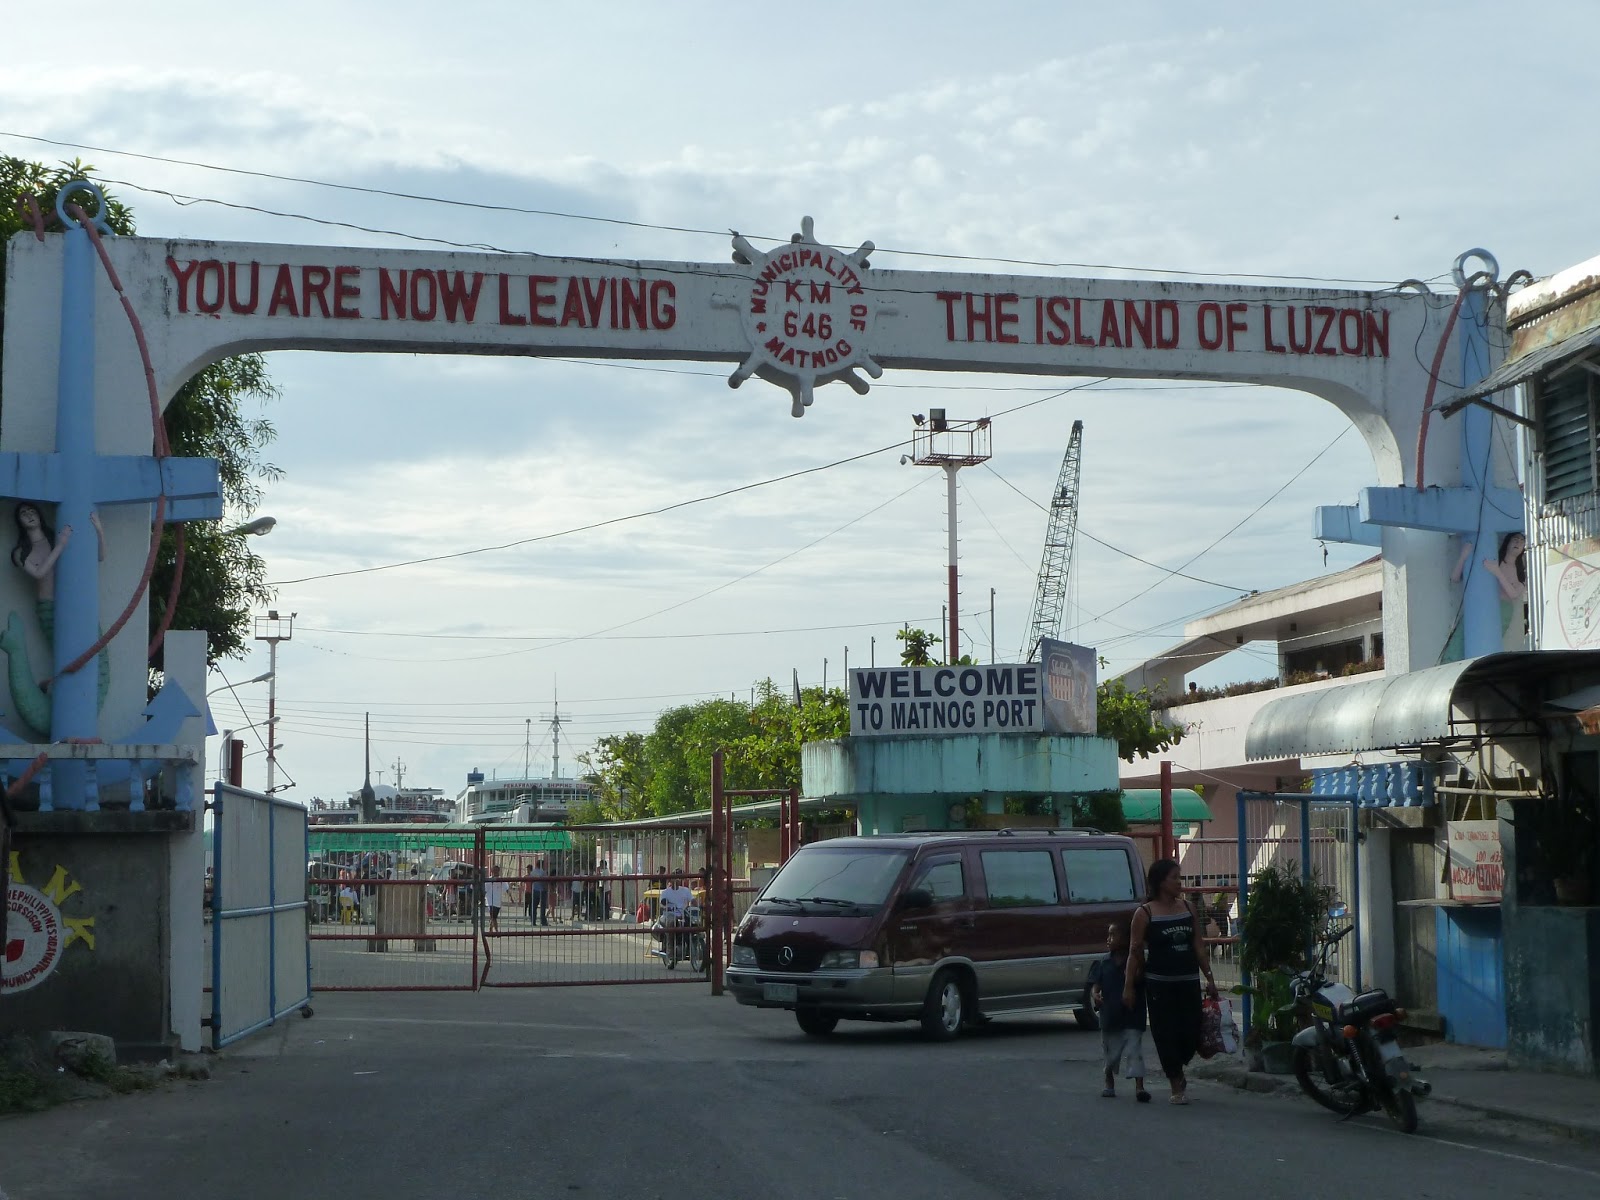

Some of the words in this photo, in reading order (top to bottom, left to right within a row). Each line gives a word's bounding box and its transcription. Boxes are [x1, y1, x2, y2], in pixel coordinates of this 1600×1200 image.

[166, 255, 260, 315] YOU
[268, 263, 360, 318] ARE
[379, 266, 484, 324] NOW
[498, 272, 676, 331] LEAVING
[751, 249, 864, 314] MUNICIPALITY
[849, 304, 867, 334] OF
[784, 310, 832, 340] 646
[936, 291, 1019, 344] THE
[1036, 295, 1179, 350] ISLAND
[1197, 302, 1248, 352] OF
[1263, 304, 1391, 359] LUZON
[765, 336, 852, 368] MATNOG
[856, 667, 1037, 699] WELCOME
[857, 702, 883, 730] TO
[891, 700, 976, 730] MATNOG
[983, 699, 1037, 727] PORT
